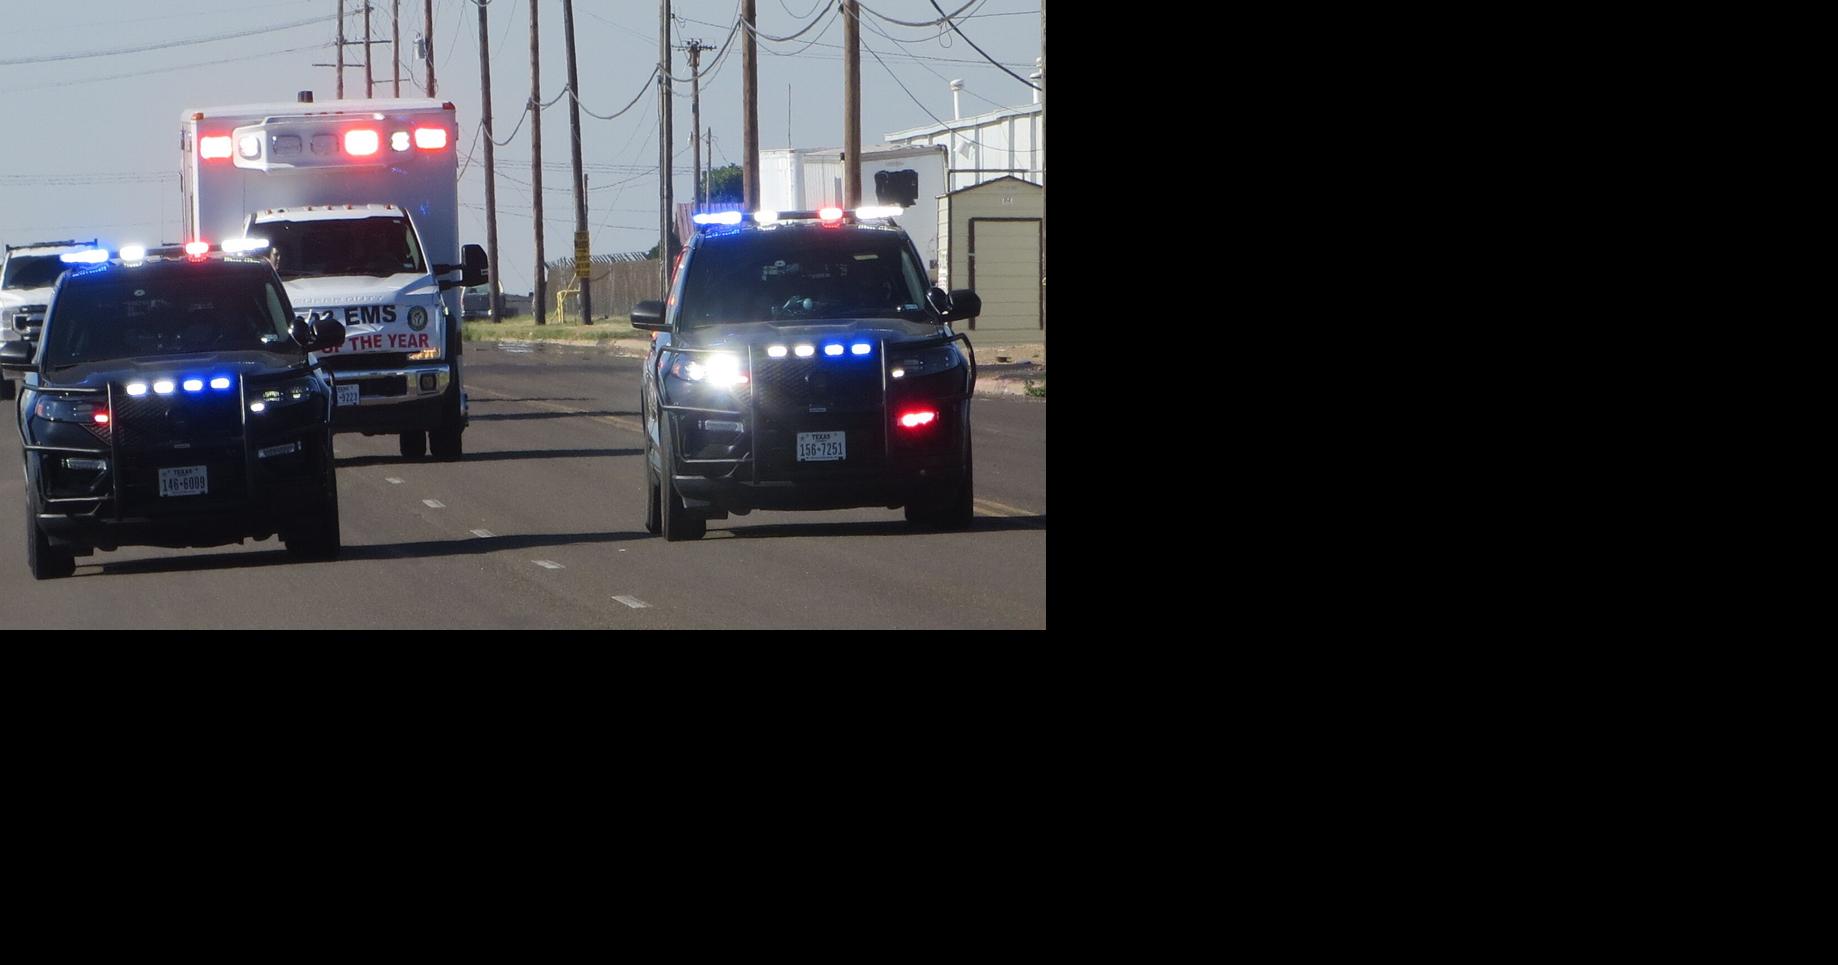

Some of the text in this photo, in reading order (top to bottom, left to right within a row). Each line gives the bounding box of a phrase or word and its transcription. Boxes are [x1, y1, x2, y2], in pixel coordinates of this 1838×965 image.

[344, 305, 397, 325] EMS
[350, 335, 382, 350] THE
[387, 333, 429, 348] YEAR
